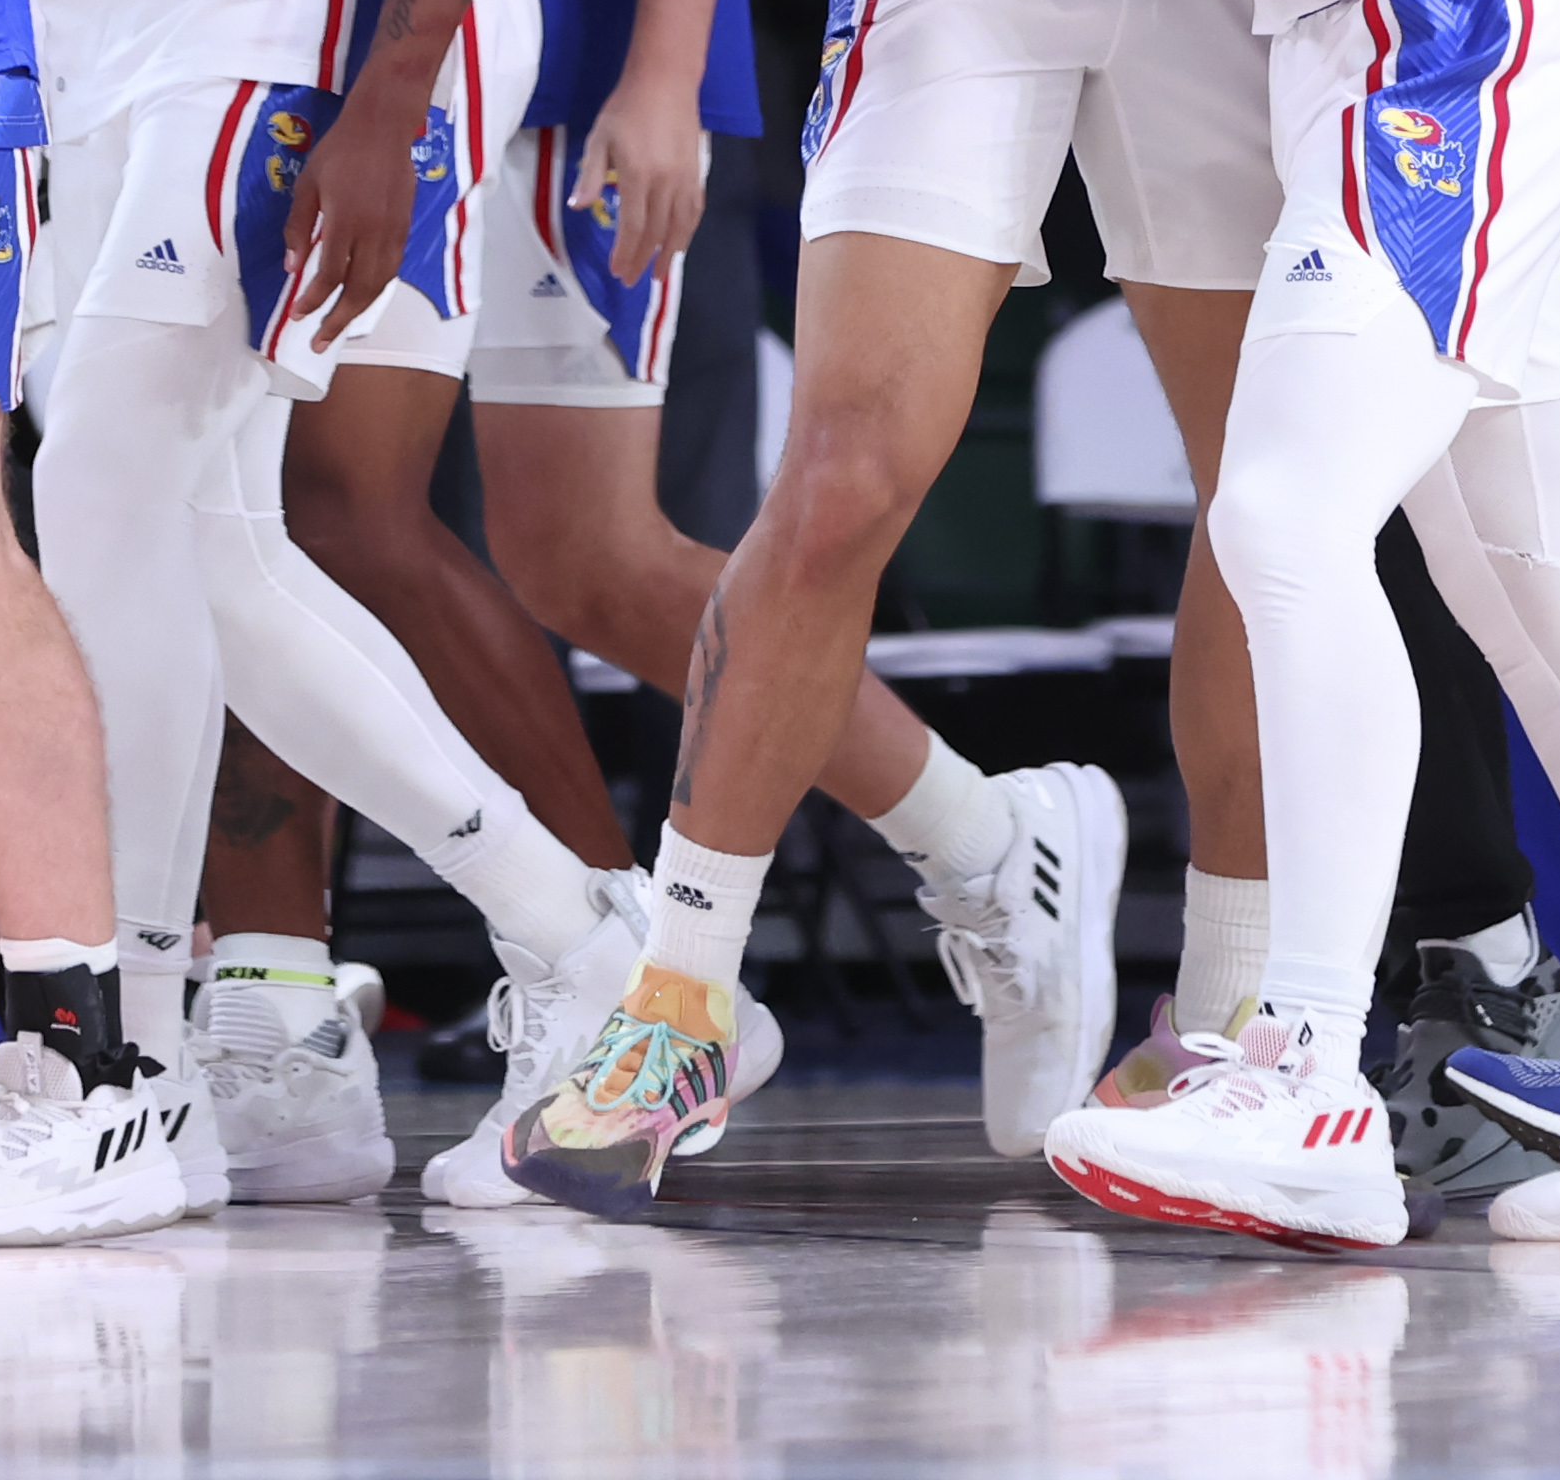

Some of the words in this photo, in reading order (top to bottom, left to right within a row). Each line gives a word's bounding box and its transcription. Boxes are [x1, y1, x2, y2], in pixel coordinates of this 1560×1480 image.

[1421, 150, 1444, 169] KU
[136, 257, 186, 275] adidas
[1285, 270, 1333, 283] adidas
[666, 886, 713, 910] adidas
